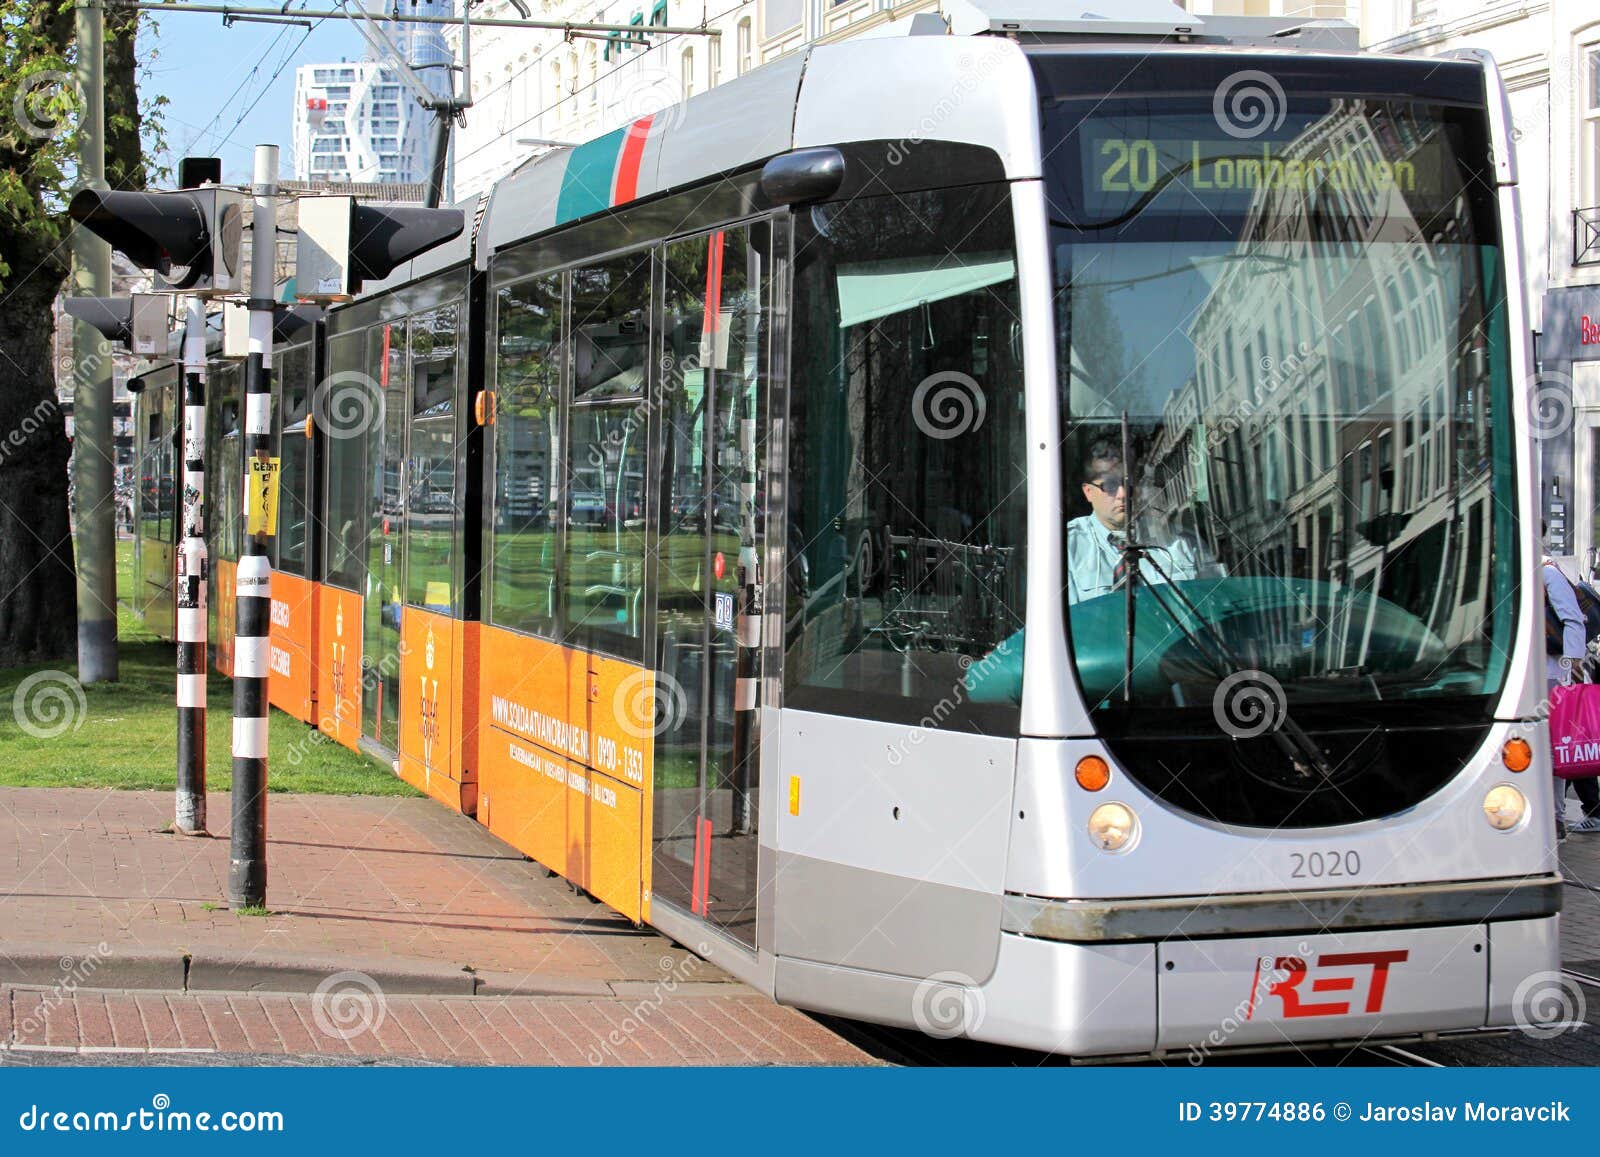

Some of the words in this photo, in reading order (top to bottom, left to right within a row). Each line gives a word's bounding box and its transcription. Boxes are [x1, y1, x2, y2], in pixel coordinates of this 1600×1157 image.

[1100, 139, 1157, 192] 20
[1581, 315, 1600, 345] Be
[597, 735, 617, 772] 0900
[623, 745, 643, 783] 1353
[1573, 743, 1600, 762] AM
[1289, 850, 1361, 879] 2020
[1247, 949, 1409, 1020] RET
